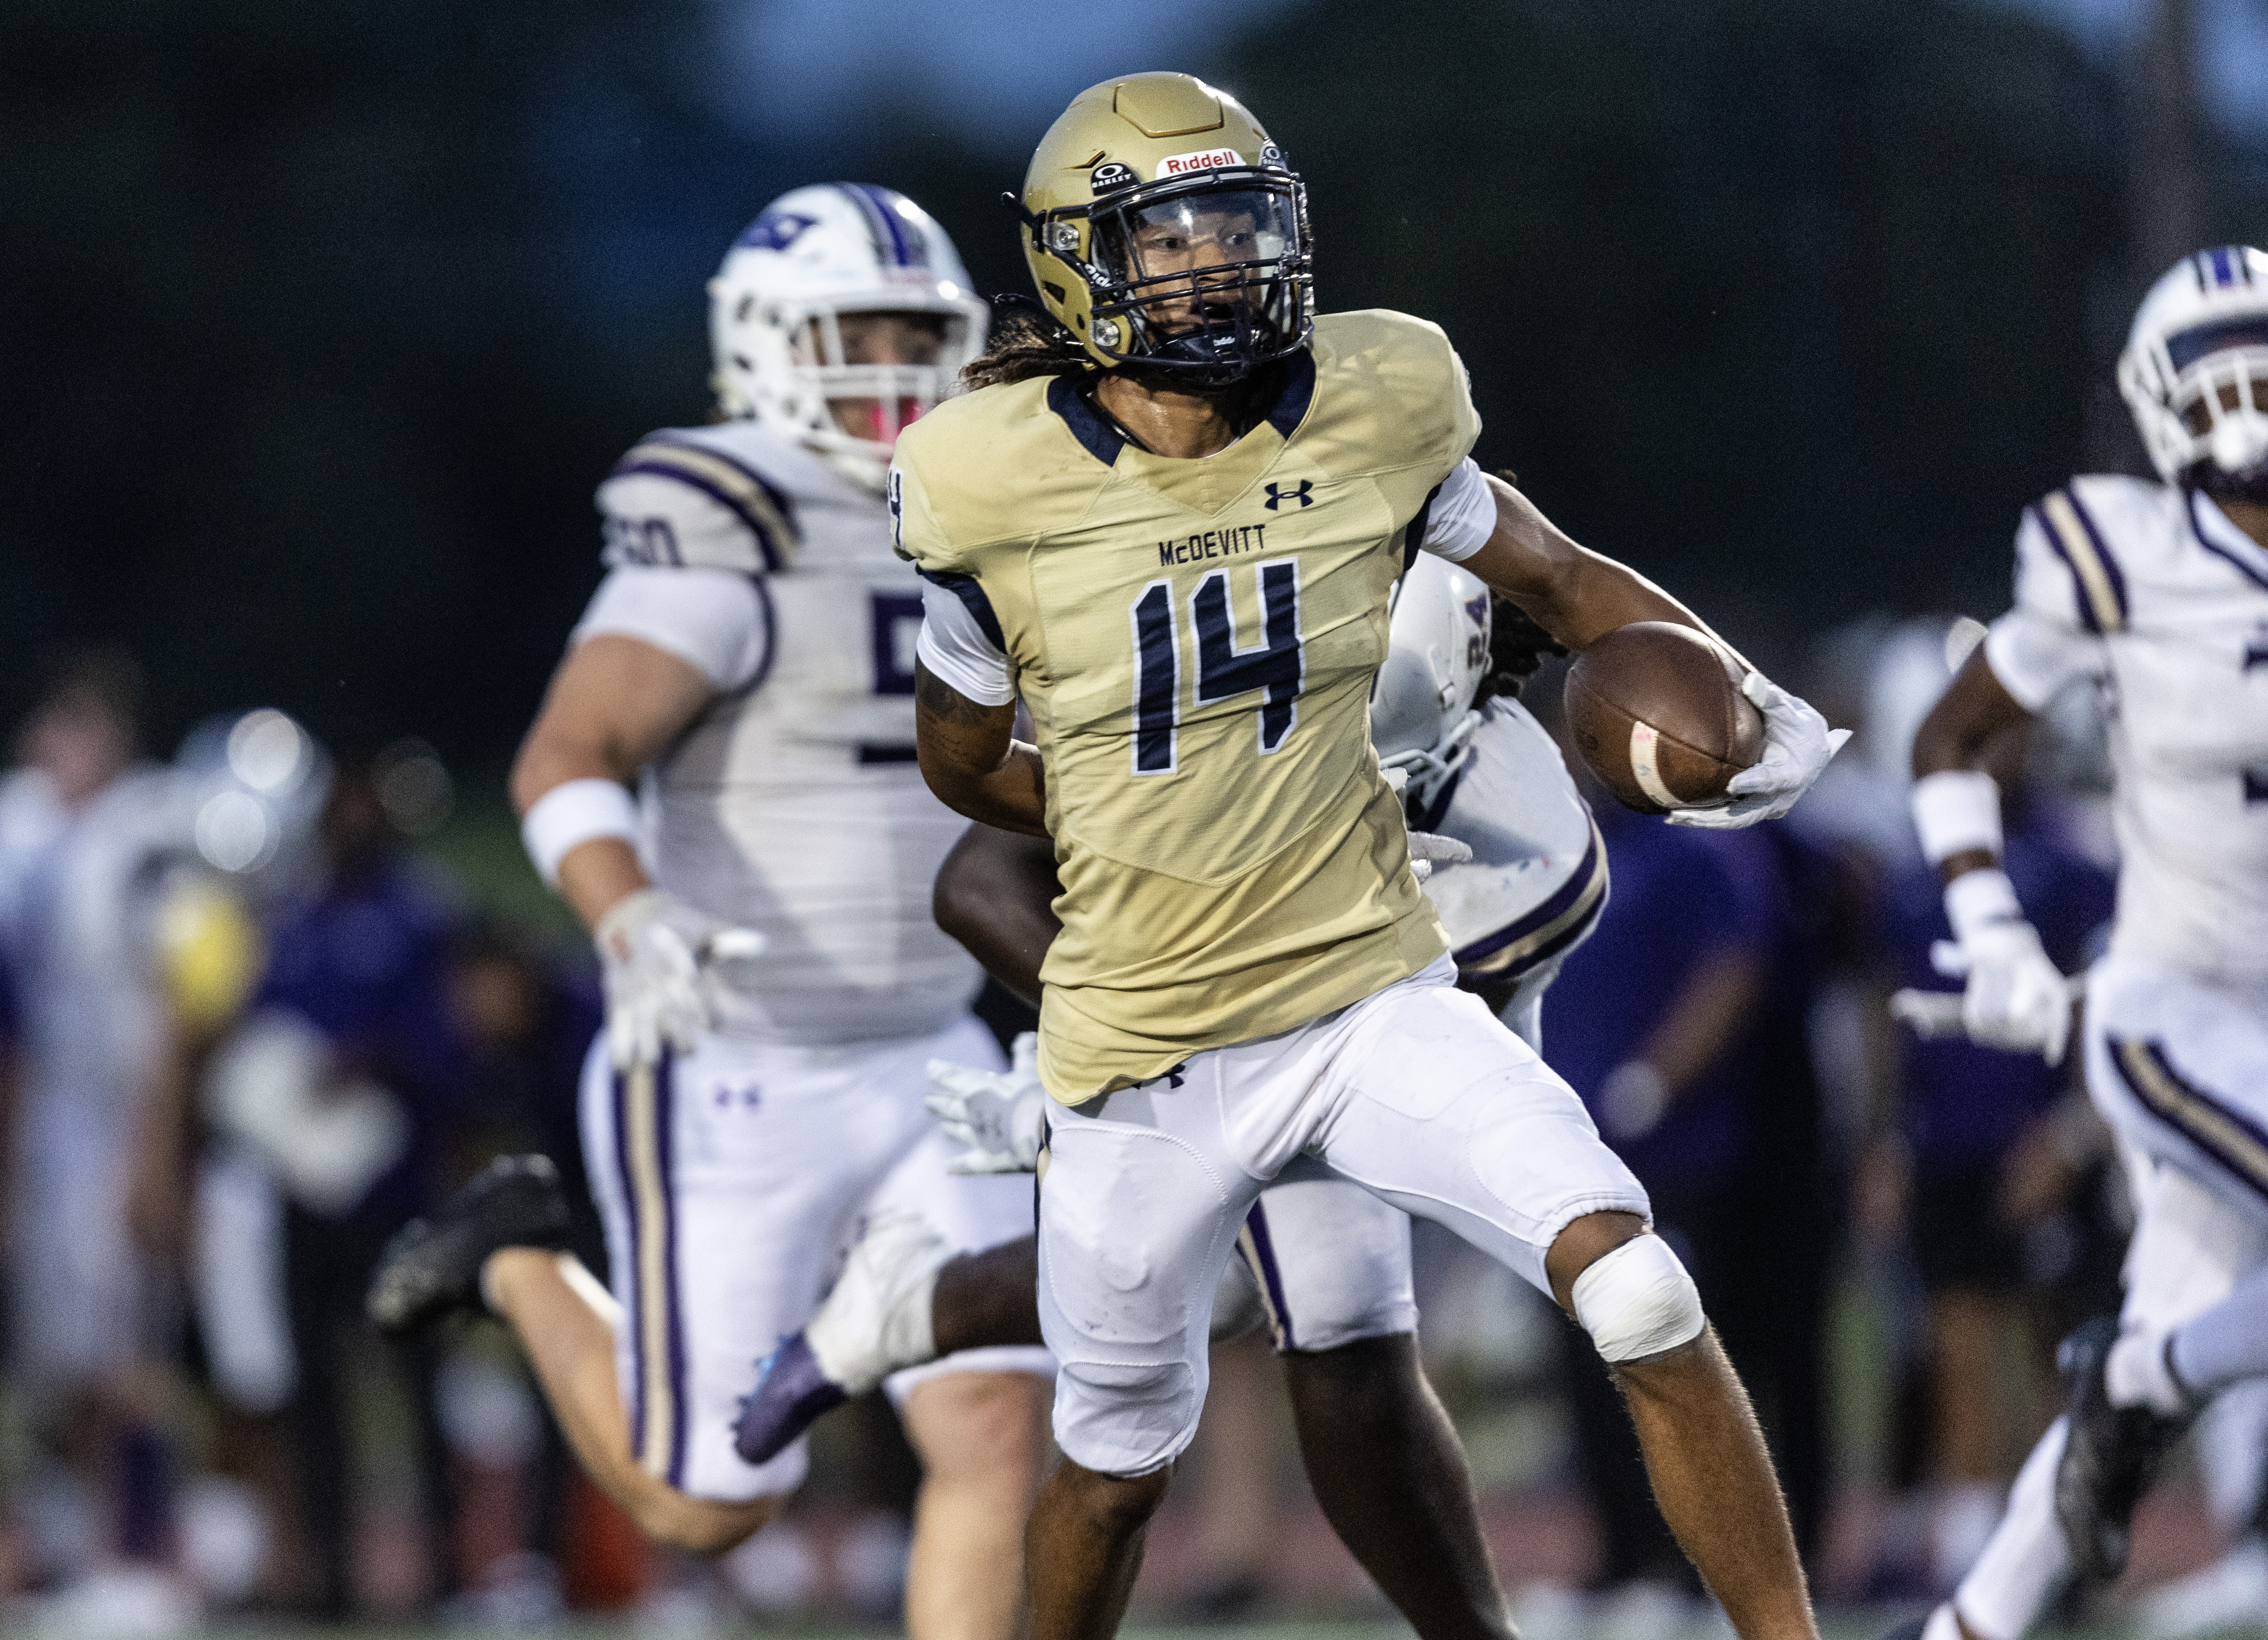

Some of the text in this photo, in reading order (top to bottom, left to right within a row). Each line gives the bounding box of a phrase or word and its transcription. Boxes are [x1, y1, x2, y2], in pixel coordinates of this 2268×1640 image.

[1166, 151, 1235, 173] Riddell
[1091, 173, 1132, 188] OAKLEY
[1158, 523, 1266, 567] McDEVITT
[1128, 556, 1307, 777] 14
